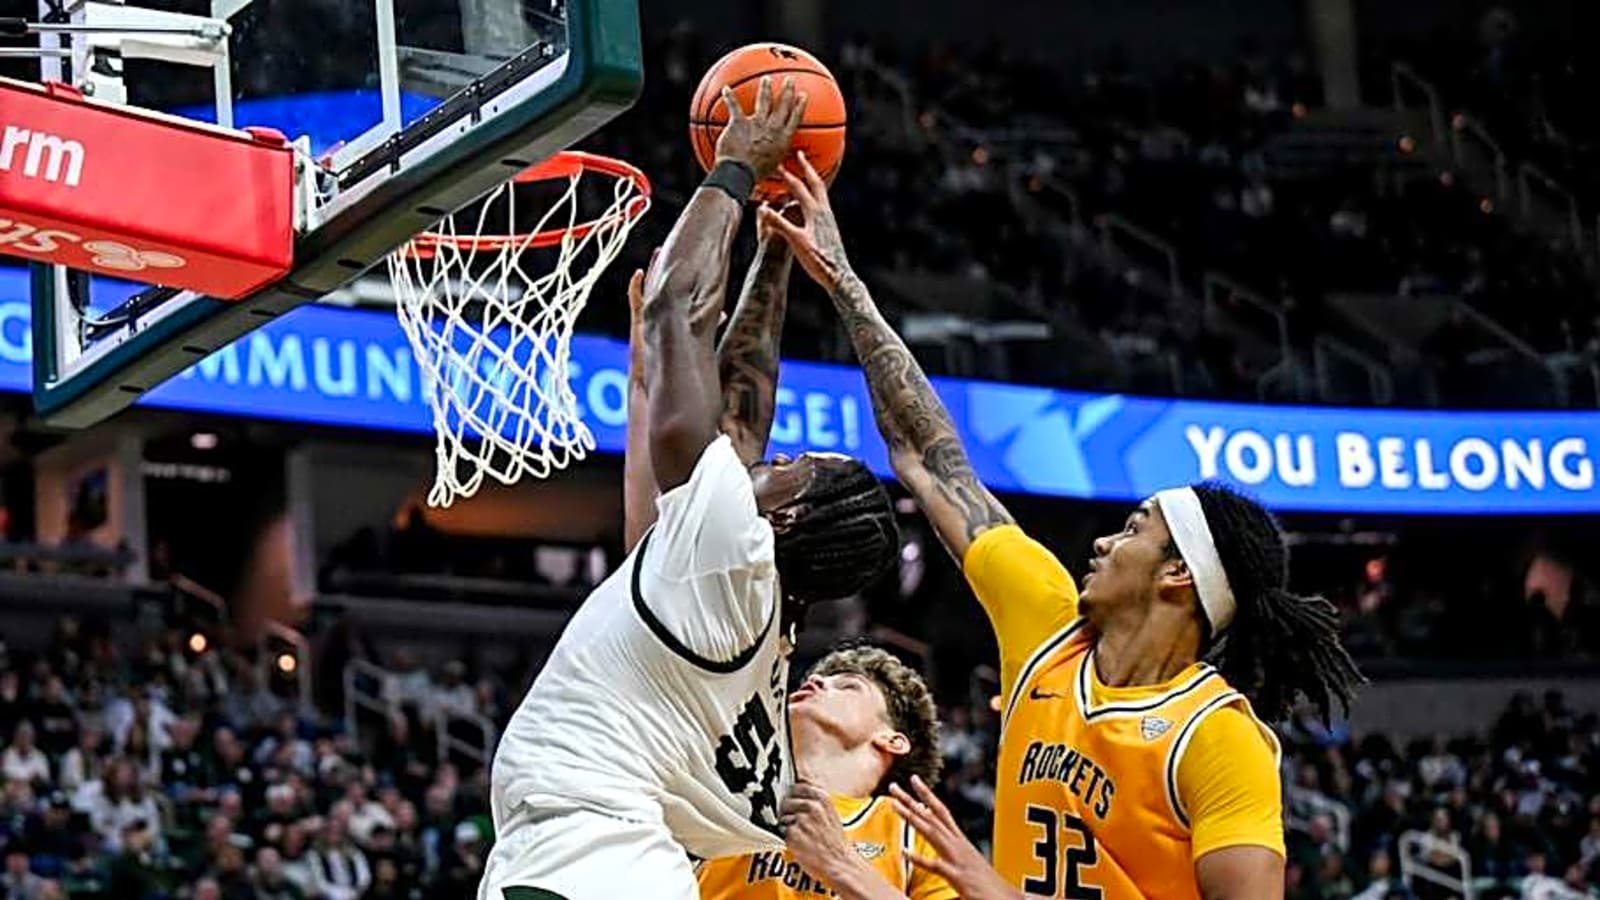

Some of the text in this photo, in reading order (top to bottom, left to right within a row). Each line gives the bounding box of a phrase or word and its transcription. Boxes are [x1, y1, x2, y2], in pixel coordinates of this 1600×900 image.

[1185, 424, 1594, 491] YOU BELONG
[1018, 740, 1116, 820] ROCKETS
[1023, 804, 1104, 900] 32
